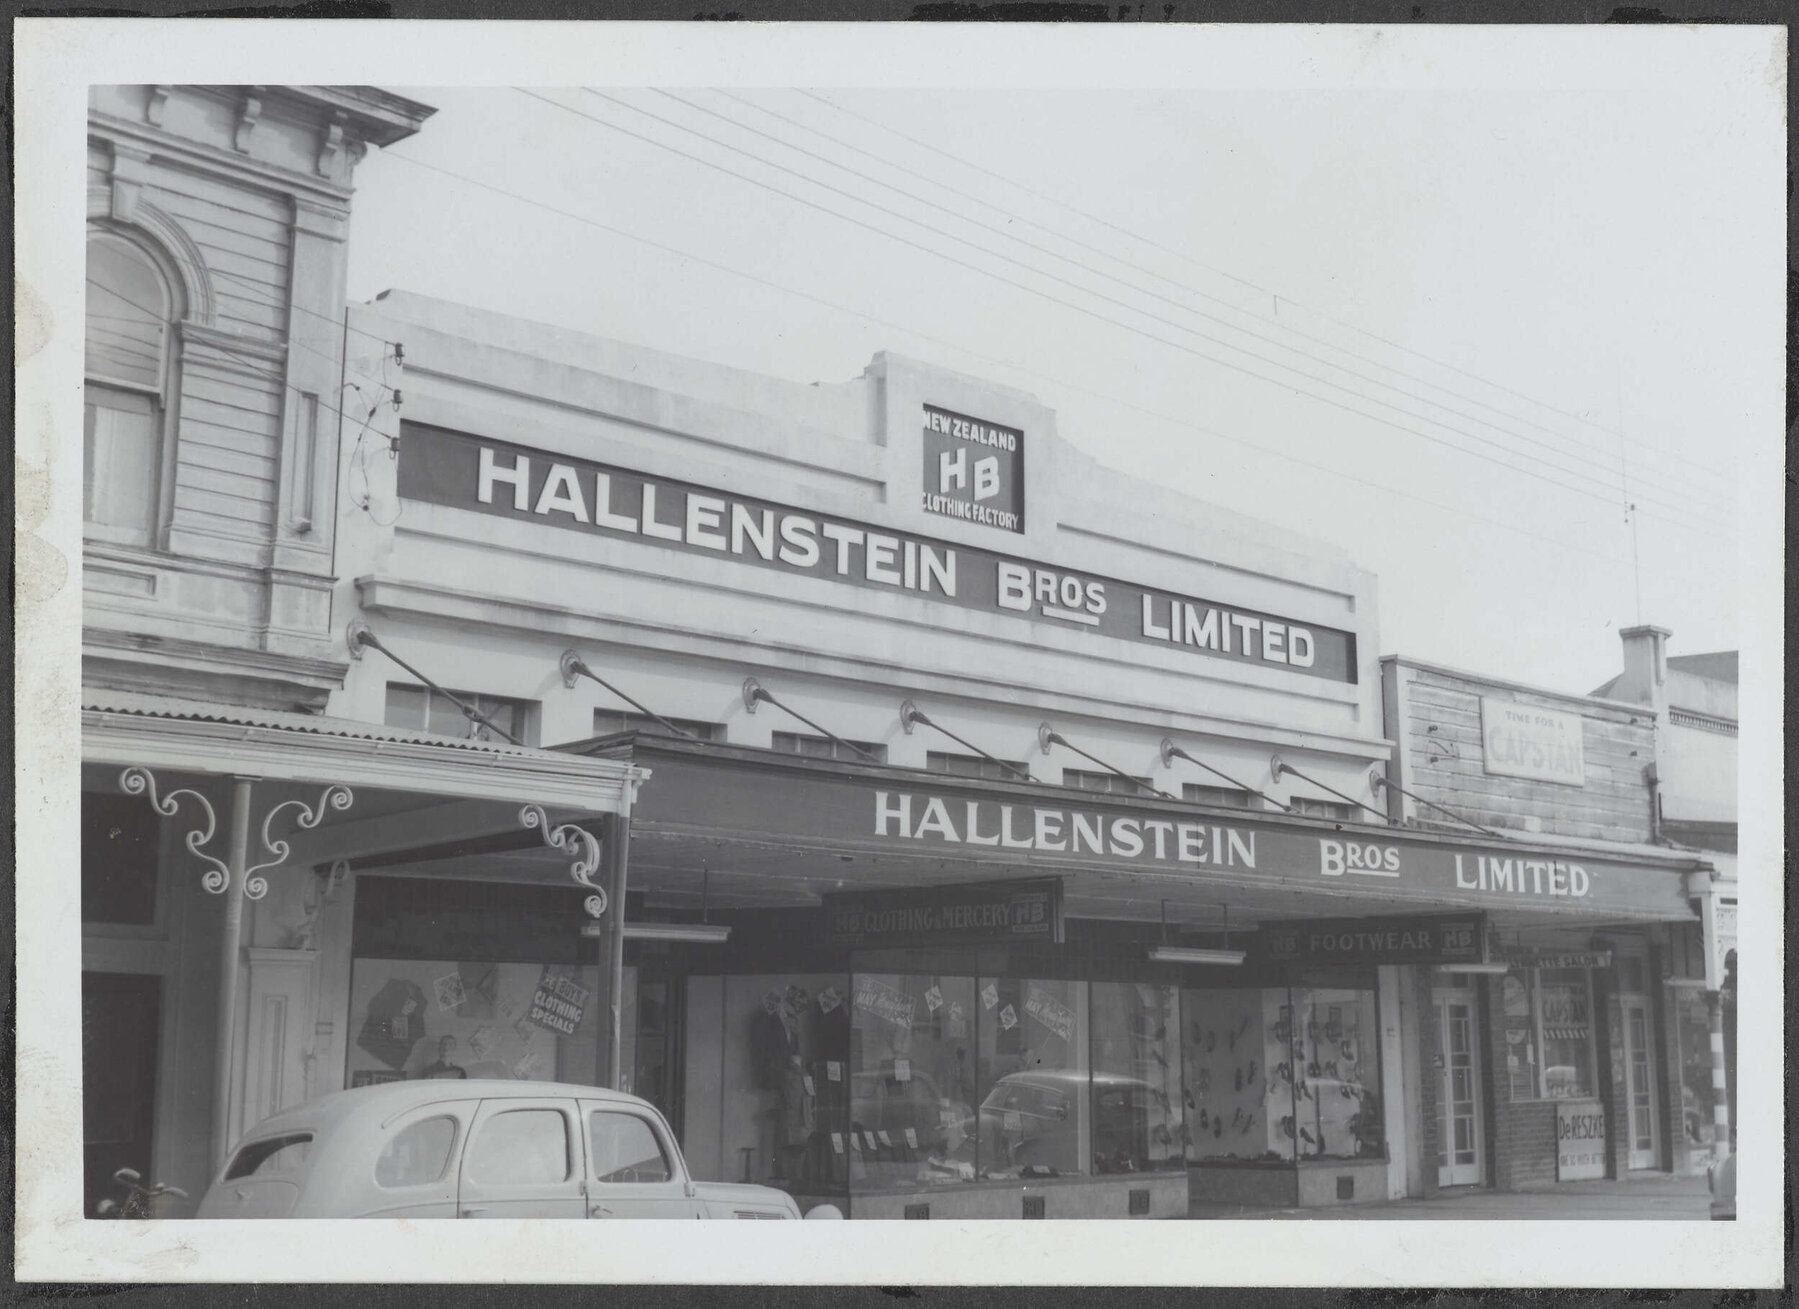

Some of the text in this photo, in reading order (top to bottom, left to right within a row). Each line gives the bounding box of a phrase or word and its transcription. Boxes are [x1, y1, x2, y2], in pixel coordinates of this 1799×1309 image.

[922, 410, 1016, 452] NEW ZEALAND
[973, 503, 1019, 530] FACTORY
[478, 447, 957, 597] HALLENSTEIN
[1143, 594, 1315, 668] LIMITED
[1506, 711, 1564, 730] TIME FOR A
[1489, 726, 1582, 777] CAPSTAN
[875, 791, 1256, 868] HALLENSTEIN
[1455, 854, 1589, 897] LIMITED
[864, 906, 933, 932] CLOTHING
[942, 904, 1012, 929] MERCERY
[1310, 931, 1432, 952] FOOTWEAR
[531, 1007, 574, 1034] SPECIALS
[535, 990, 582, 1022] CLOTHING
